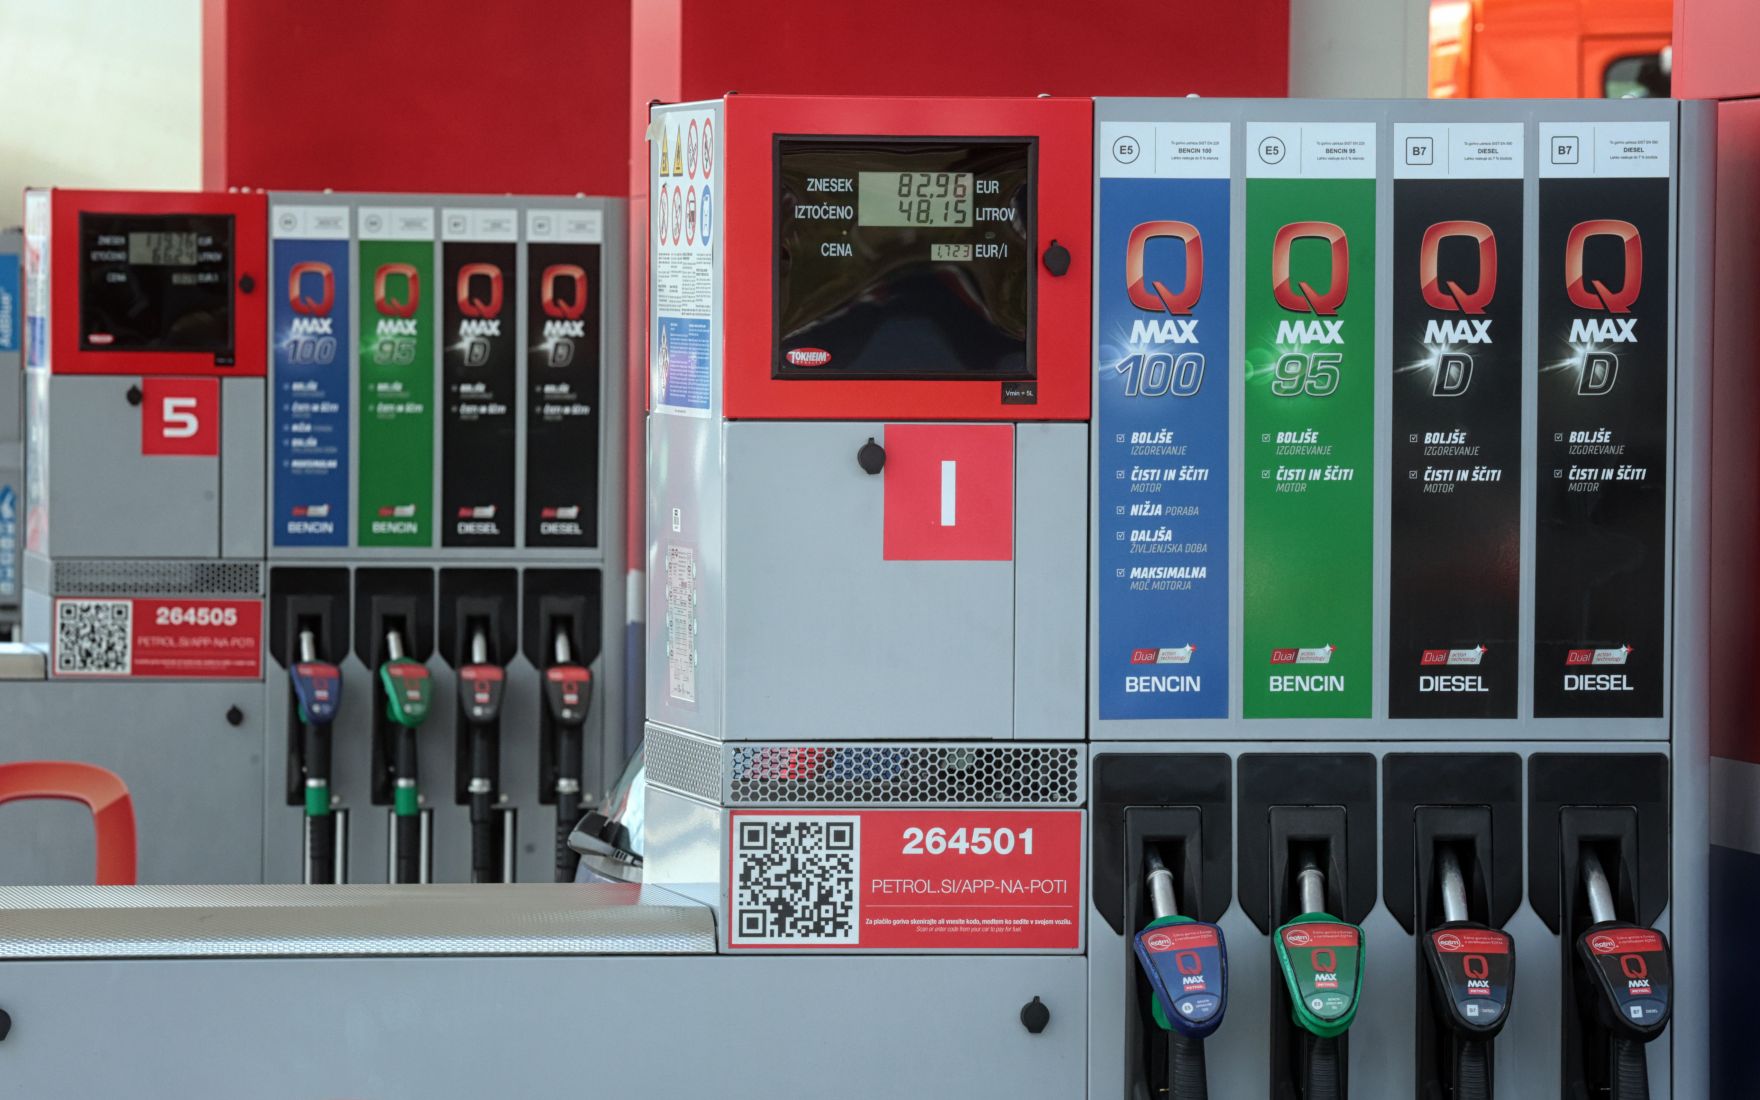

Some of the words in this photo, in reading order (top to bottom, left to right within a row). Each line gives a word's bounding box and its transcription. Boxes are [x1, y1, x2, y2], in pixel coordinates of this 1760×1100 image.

[1120, 145, 1133, 155] E5
[1265, 146, 1279, 155] E5
[1412, 147, 1426, 156] B7
[1558, 146, 1572, 155] B7
[807, 178, 853, 192] ZNESEK
[976, 180, 999, 193] EUR
[794, 202, 853, 219] IZTOČENO
[976, 207, 1015, 221] LITROV
[820, 243, 853, 257] CENA
[1126, 220, 1204, 316] Q
[1272, 221, 1349, 316] Q
[1420, 220, 1498, 315] Q
[1565, 219, 1643, 314] Q
[289, 261, 335, 317] Q
[374, 263, 419, 318] Q
[457, 263, 503, 318] Q
[541, 264, 587, 319] Q
[291, 317, 332, 334] MAX
[376, 319, 417, 335] MAX
[459, 319, 500, 336] MAX
[544, 320, 584, 337] MAX
[1129, 319, 1199, 344] MAX
[1275, 320, 1345, 344] MAX
[1423, 319, 1493, 344] MAX
[1568, 318, 1638, 343] MAX
[286, 337, 337, 364] 100
[373, 338, 416, 365] 95
[464, 337, 491, 366] D
[548, 338, 575, 367] D
[788, 352, 826, 363] TOKHEIM
[1115, 352, 1205, 397] 100
[1271, 353, 1343, 397] 95
[1432, 352, 1474, 397] D
[1578, 351, 1619, 396] D
[163, 397, 199, 438] 5
[1131, 428, 1173, 444] BOLJŠE
[1276, 428, 1318, 444] BOLJŠE
[1424, 429, 1467, 444] BOLJŠE
[1569, 428, 1612, 443] BOLJŠE
[1130, 446, 1187, 456] IZGOREVANJE
[1276, 446, 1332, 456] IZGOREVANJE
[1423, 446, 1480, 456] IZGOREVANJE
[1568, 445, 1625, 455] IZGOREVANJE
[1131, 466, 1160, 481] ČISTI
[1163, 469, 1175, 481] IN
[1178, 466, 1209, 481] ŠČITI
[1276, 466, 1305, 481] ČISTI
[1308, 469, 1320, 481] IN
[1324, 466, 1354, 481] ŠČITI
[1424, 466, 1453, 481] ČISTI
[1456, 470, 1468, 481] IN
[1471, 466, 1502, 481] ŠČITI
[1568, 465, 1598, 480] ČISTI
[1601, 469, 1613, 480] IN
[1616, 465, 1647, 480] ŠČITI
[1130, 482, 1161, 493] MOTOR
[1276, 482, 1307, 493] MOTOR
[1423, 483, 1454, 493] MOTOR
[1568, 482, 1599, 492] MOTOR
[1130, 501, 1162, 516] NIŽJA
[1165, 506, 1199, 516] PORABA
[288, 522, 333, 533] BENCIN
[372, 522, 418, 533] BENCIN
[457, 522, 499, 534] DIESEL
[540, 522, 582, 535] DIESEL
[1130, 526, 1172, 542] DALJŠA
[1130, 541, 1183, 553] ŽIVLJENJSKA
[1185, 543, 1207, 553] DOBA
[1130, 567, 1207, 579] MAKSIMALNA
[1130, 579, 1150, 591] MOČ
[1151, 581, 1191, 591] MOTORJA
[155, 607, 238, 626] 264505
[1134, 651, 1156, 661] Dual
[1273, 651, 1295, 661] Dual
[1424, 652, 1446, 662] Dual
[1569, 652, 1591, 662] Dual
[1125, 676, 1200, 692] BENCIN
[1269, 675, 1345, 692] BENCIN
[1419, 676, 1489, 692] DIESEL
[1564, 675, 1634, 691] DIESEL
[902, 827, 1033, 855] 264501
[872, 878, 1067, 894] PETROL.SI/APP-NA-POTI
[1176, 951, 1203, 975] Q
[1311, 948, 1337, 973] Q
[1463, 954, 1489, 979] Q
[1620, 954, 1648, 978] Q
[1183, 975, 1205, 985] MAX
[1315, 973, 1337, 981] MAX
[1468, 980, 1490, 988] MAX
[1628, 979, 1650, 988] MAX
